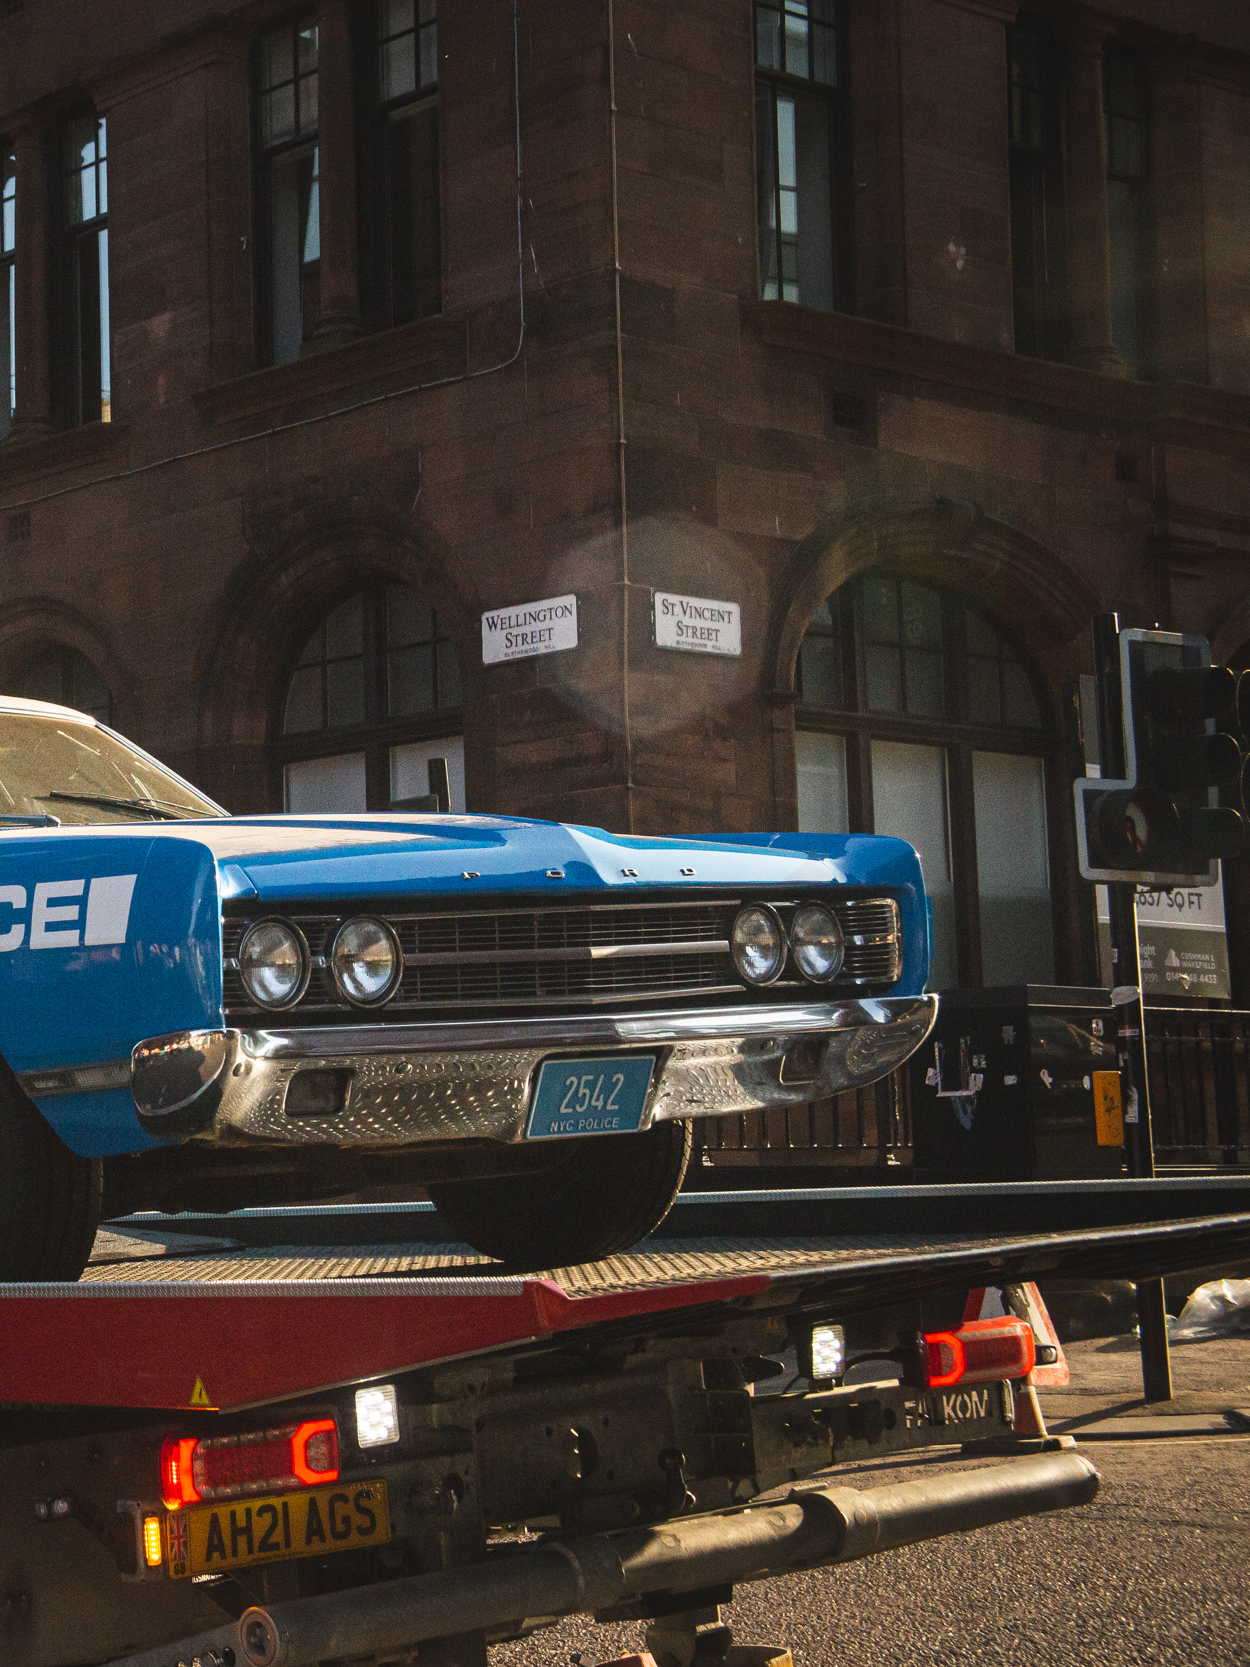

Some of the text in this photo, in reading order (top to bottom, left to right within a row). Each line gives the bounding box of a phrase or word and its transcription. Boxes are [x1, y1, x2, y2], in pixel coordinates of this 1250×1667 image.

[485, 603, 573, 632] WELLINGTON
[679, 600, 733, 623] VINCENT
[505, 627, 554, 648] STREET
[676, 620, 720, 642] STREET
[461, 866, 697, 880] FORD
[1164, 890, 1184, 912] SQ
[1188, 892, 1202, 910] FT
[1181, 961, 1216, 970] WAKEFIELD
[559, 1073, 624, 1114] 2542
[550, 1117, 620, 1132] NYC POLICE
[205, 1489, 377, 1562] AH21 AGS
[174, 1562, 186, 1575] GB
